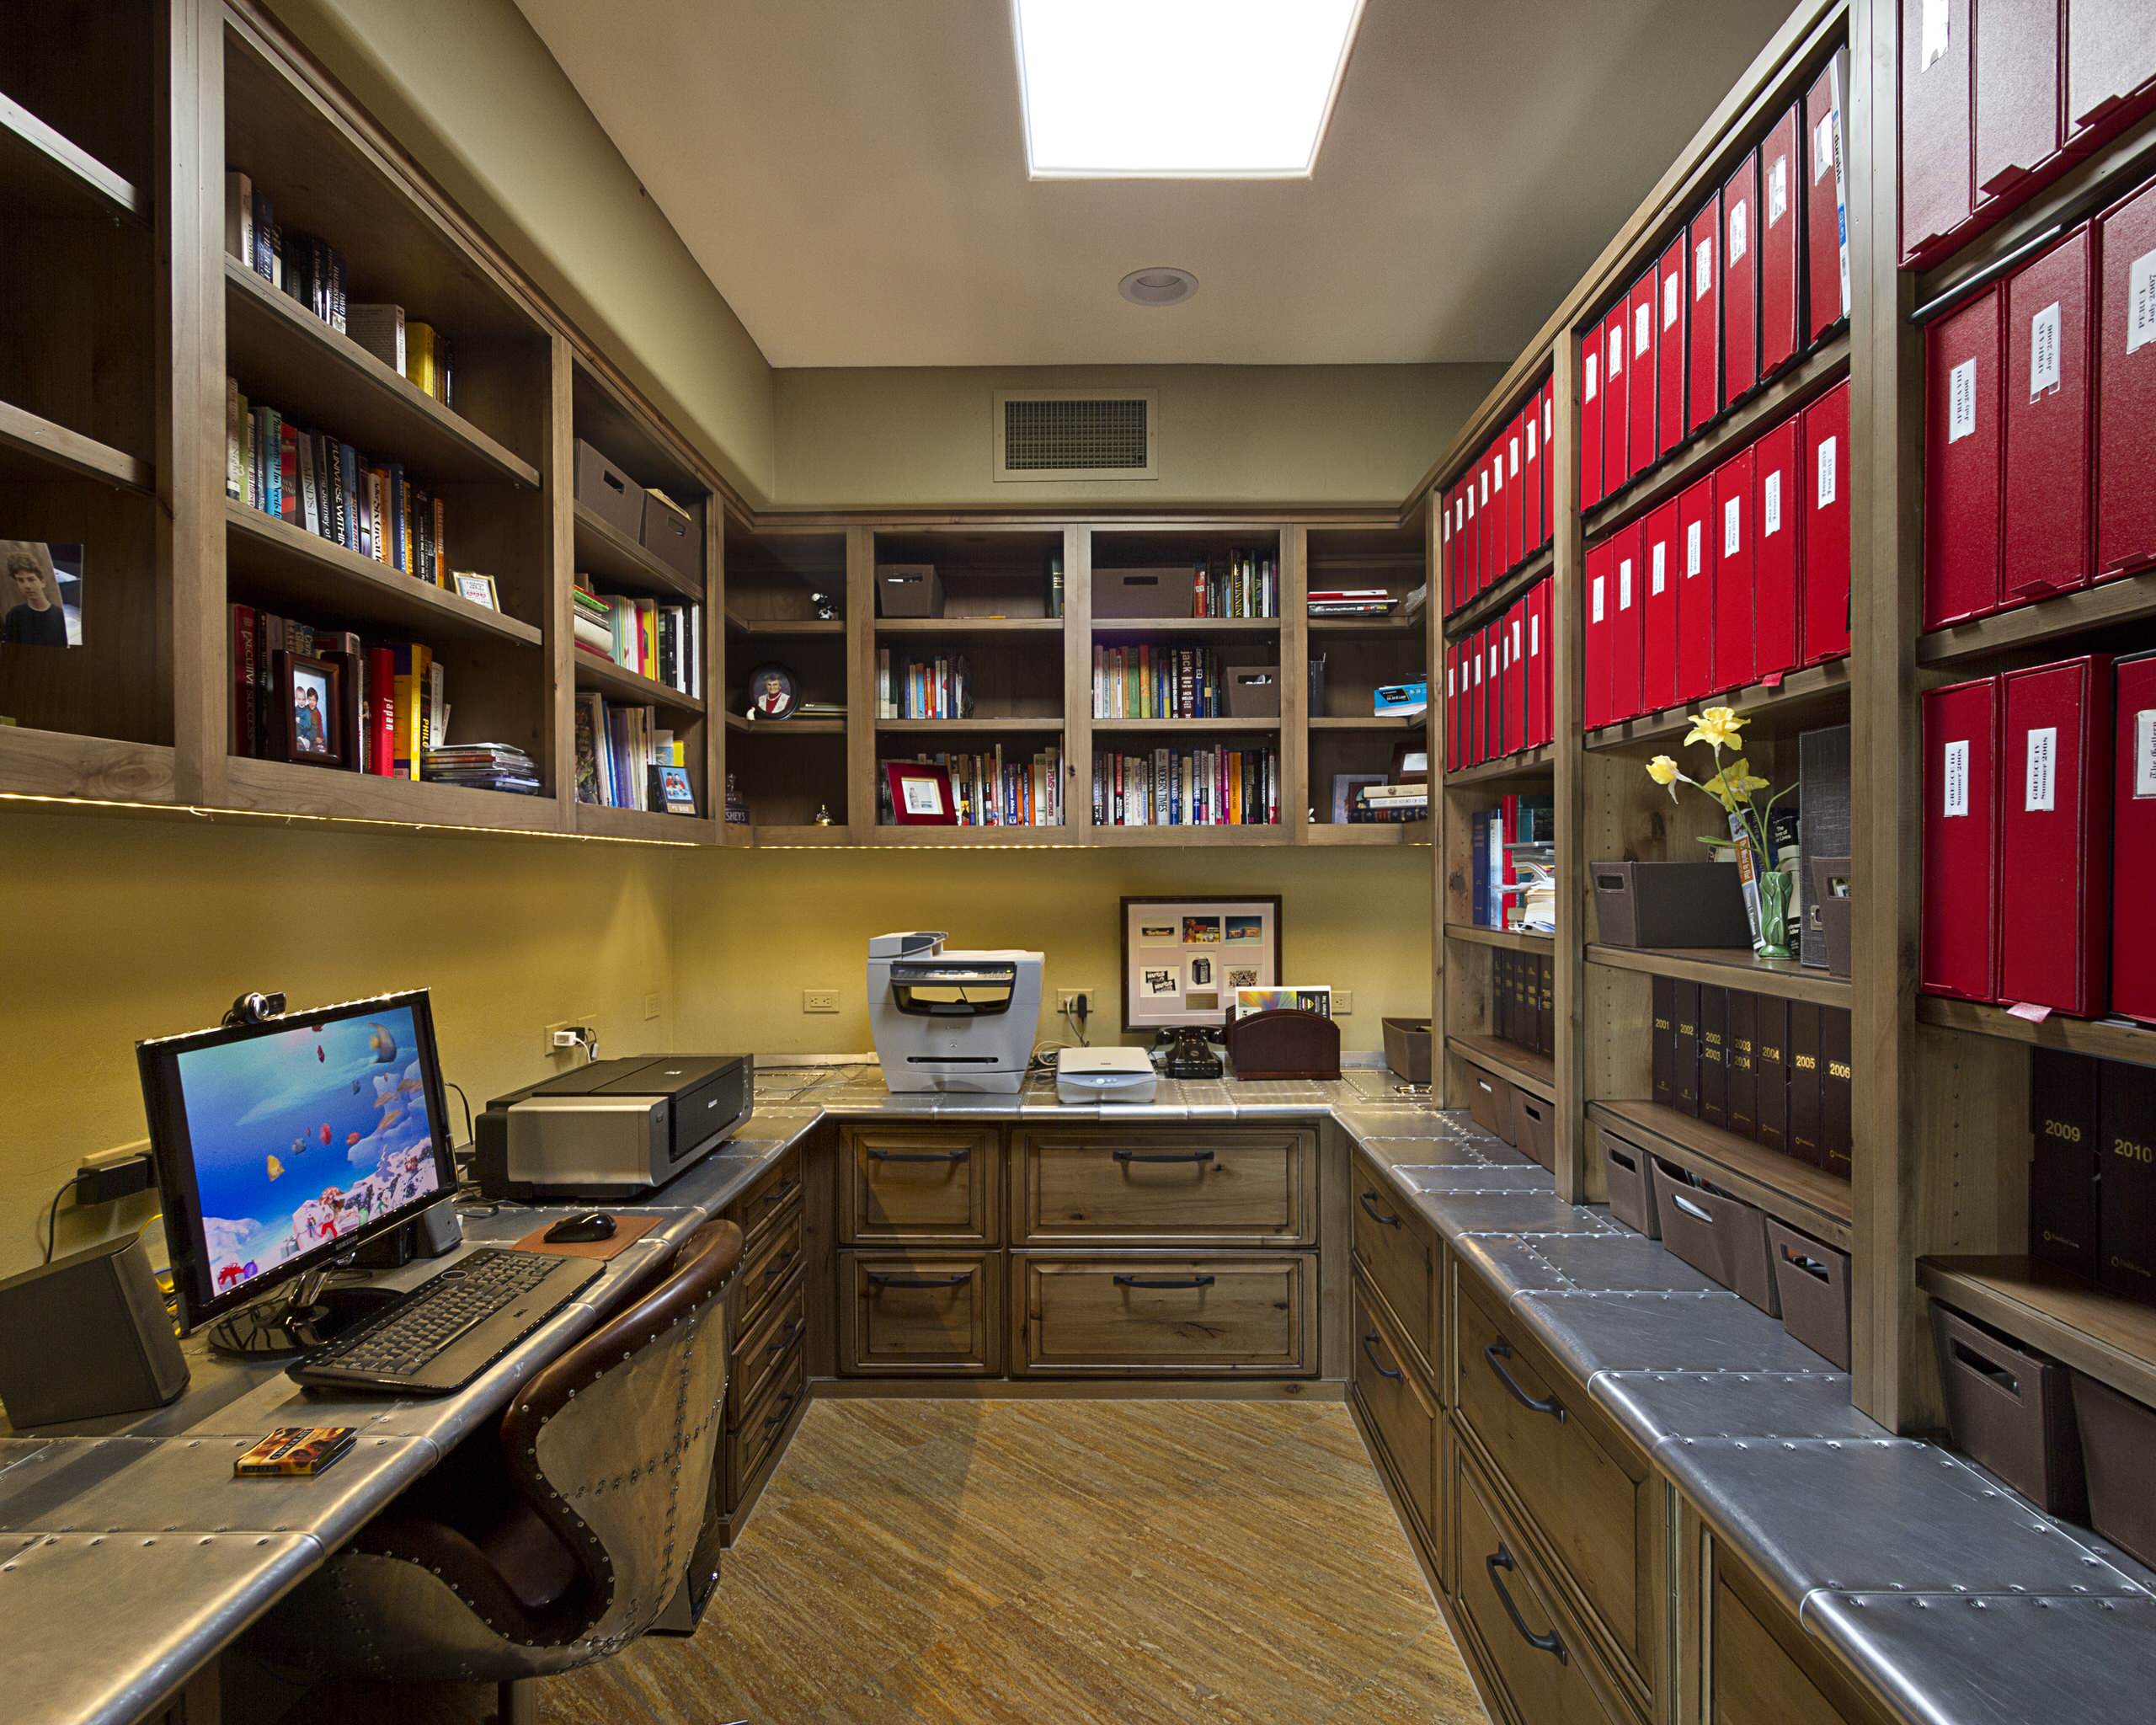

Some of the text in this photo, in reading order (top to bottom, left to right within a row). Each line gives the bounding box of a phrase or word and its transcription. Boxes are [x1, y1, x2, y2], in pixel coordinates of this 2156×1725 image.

[332, 449, 343, 504] UNIVERSE
[321, 490, 330, 526] Journey
[324, 527, 331, 540] of
[1180, 650, 1193, 673] jack
[1158, 765, 1167, 813] MODERN TIMES
[1655, 1018, 1669, 1030] 2001
[1679, 1024, 1694, 1036] 2002
[1705, 1032, 1721, 1045] 2002
[1734, 1039, 1752, 1052] 2003
[1705, 1048, 1721, 1061] 2003
[1762, 1046, 1780, 1061] 2004
[1734, 1055, 1751, 1070] 2004
[1796, 1055, 1817, 1070] 2005
[1829, 1062, 1851, 1079] 2006
[2045, 1119, 2081, 1143] 2009
[2114, 1138, 2153, 1164] 2010
